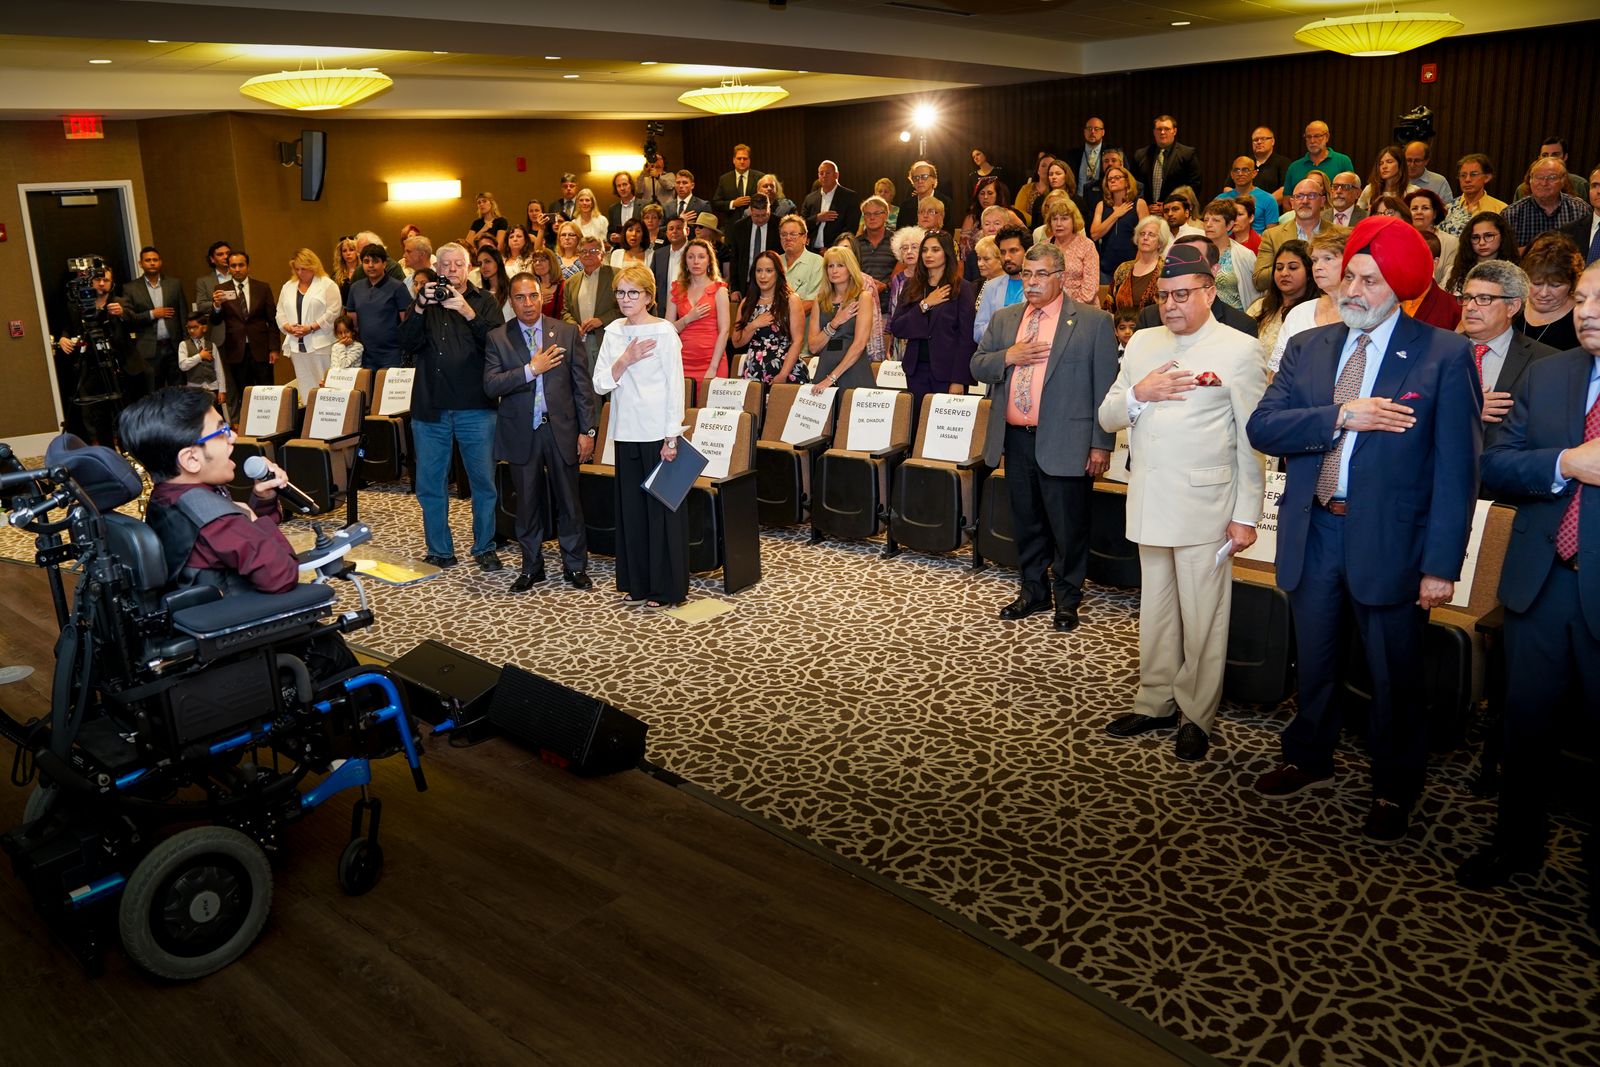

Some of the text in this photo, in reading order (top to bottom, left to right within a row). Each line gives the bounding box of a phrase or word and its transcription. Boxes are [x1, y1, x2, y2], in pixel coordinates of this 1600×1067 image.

[71, 117, 97, 137] EXIT
[320, 395, 346, 403] RESERVED
[799, 397, 827, 410] RESERVED
[856, 401, 890, 409] RESERVED
[934, 407, 972, 417] RESERVED
[700, 423, 733, 432] RESERVED
